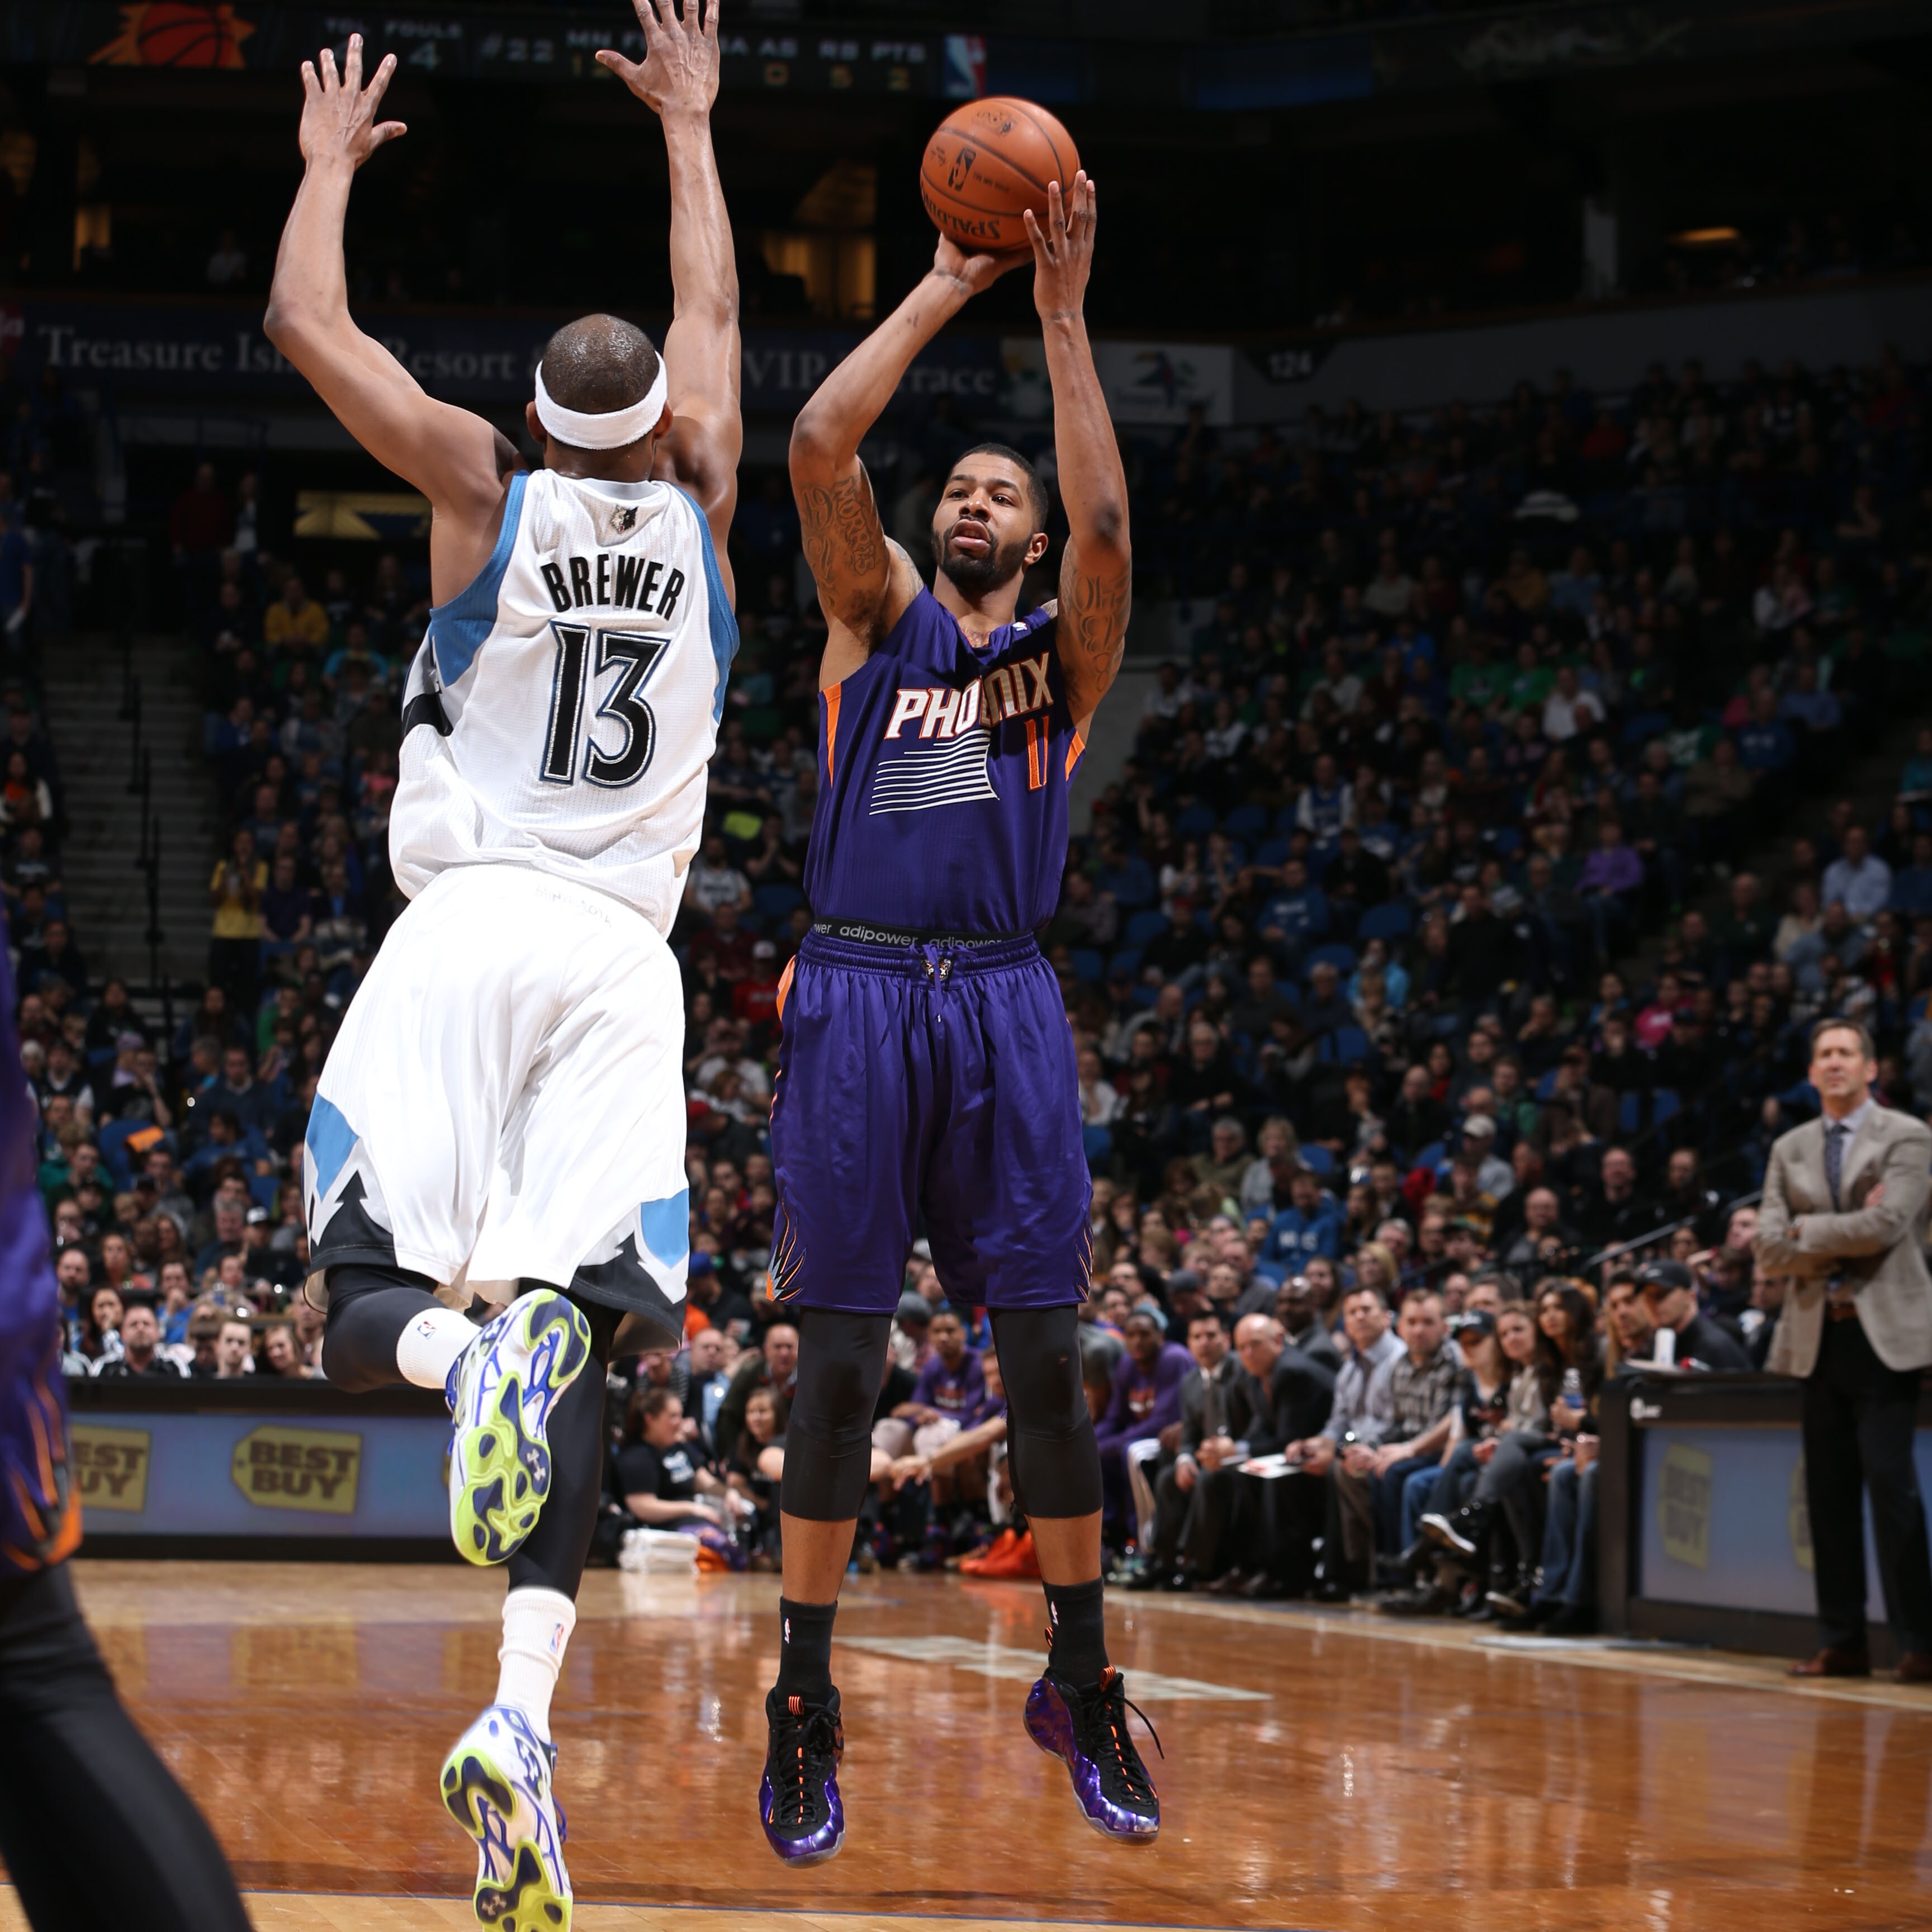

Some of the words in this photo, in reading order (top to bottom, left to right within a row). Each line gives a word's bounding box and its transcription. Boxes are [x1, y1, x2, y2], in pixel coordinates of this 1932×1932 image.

[37, 324, 224, 372] Treasure
[741, 349, 827, 391] VIP
[1267, 352, 1312, 379] 124
[540, 553, 685, 621] BREWER
[539, 618, 671, 789] 13
[1024, 716, 1050, 790] 11
[840, 925, 918, 946] adipower
[72, 1441, 145, 1470] EST
[249, 1440, 356, 1472] BEST
[77, 1470, 132, 1497] UY
[251, 1469, 345, 1499] BUY
